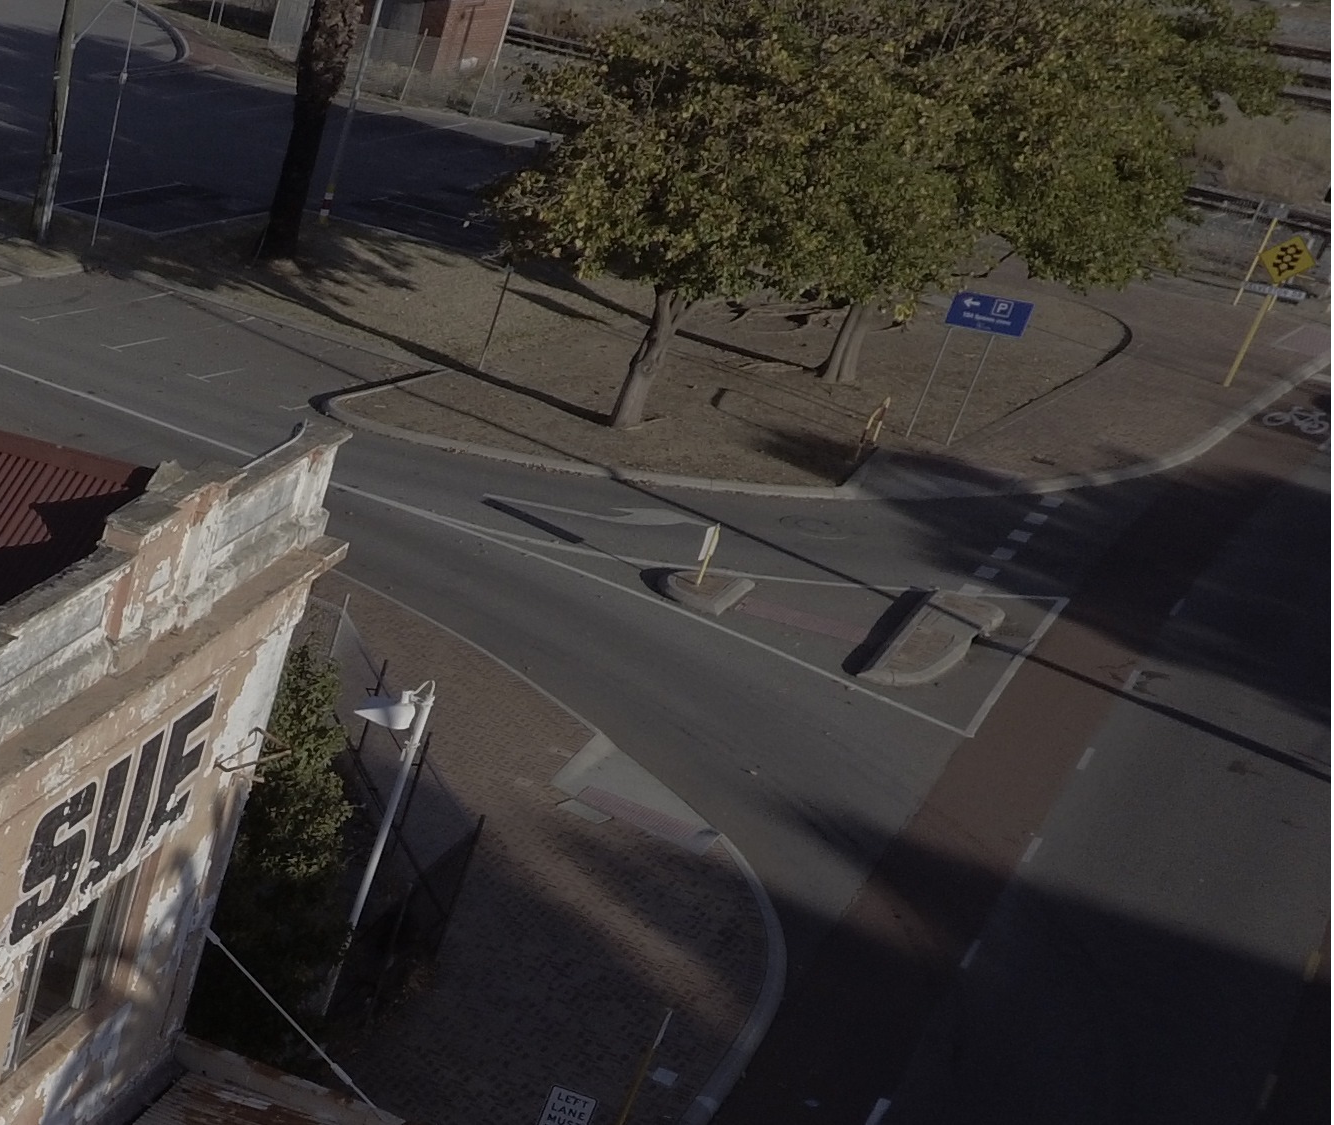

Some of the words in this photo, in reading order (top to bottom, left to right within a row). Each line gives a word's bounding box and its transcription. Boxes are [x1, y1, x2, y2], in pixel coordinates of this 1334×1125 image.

[10, 692, 217, 947] SUE
[557, 1092, 588, 1108] LEFT
[551, 1102, 586, 1120] LANE
